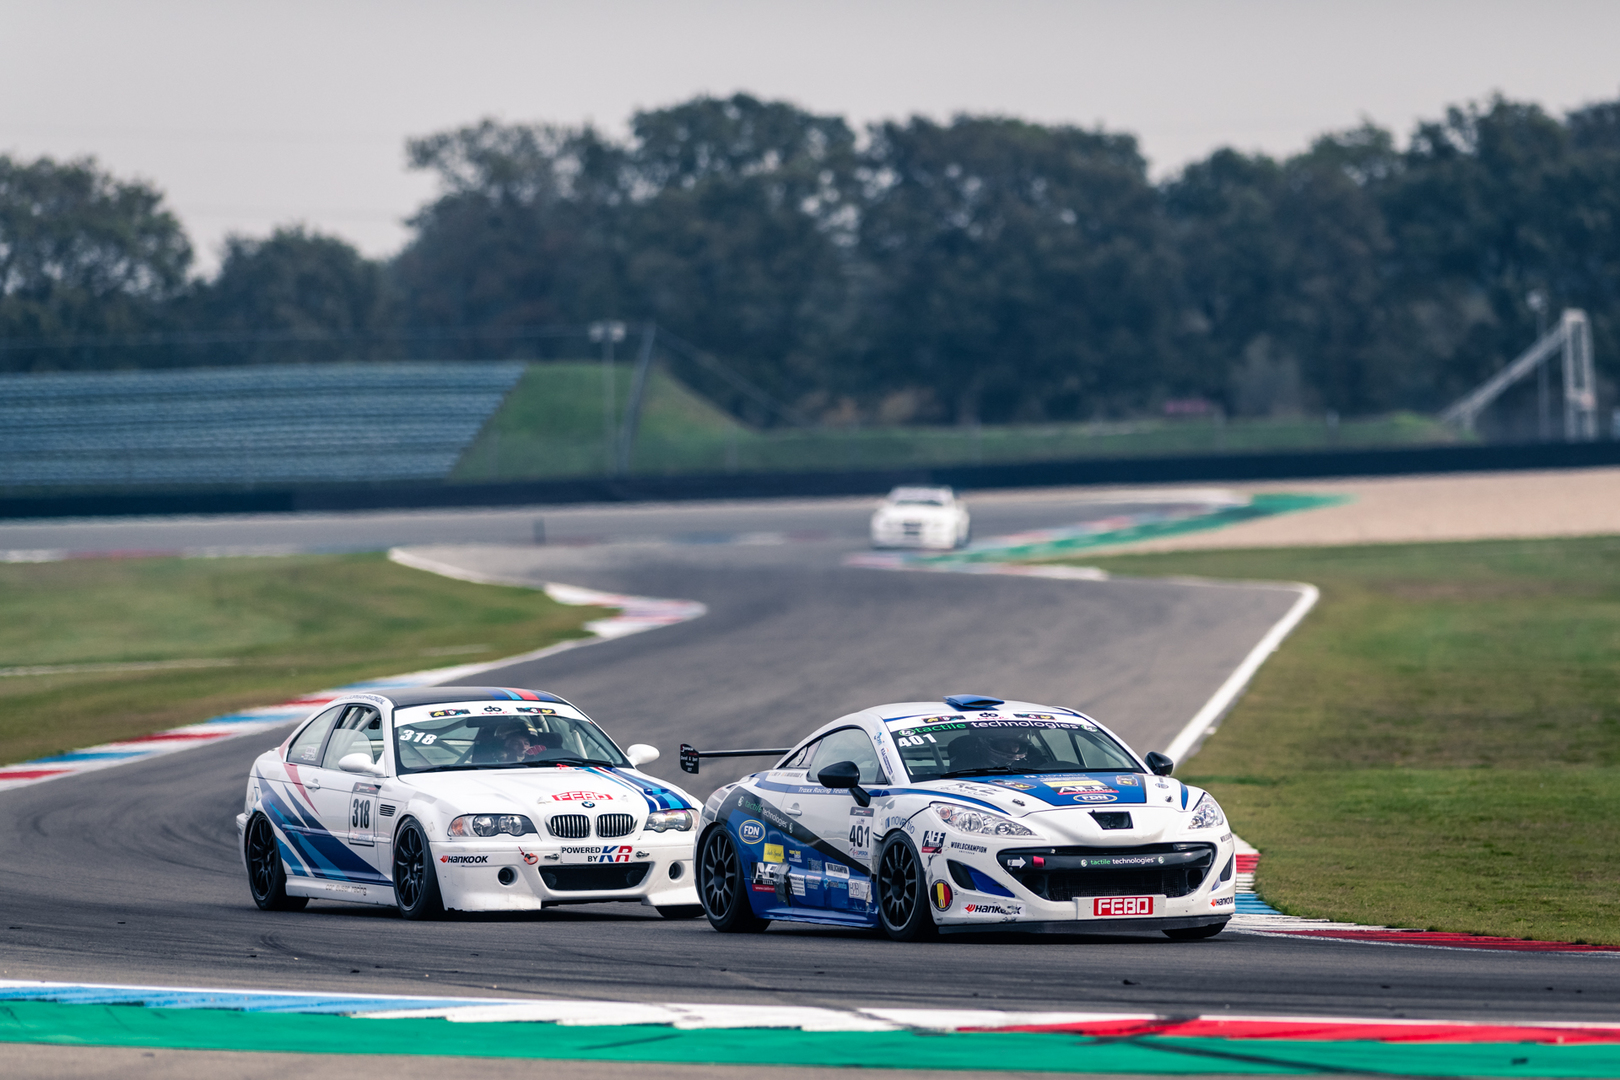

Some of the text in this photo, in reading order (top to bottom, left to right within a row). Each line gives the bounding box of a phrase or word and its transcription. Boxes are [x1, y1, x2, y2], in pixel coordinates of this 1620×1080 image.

[915, 720, 1079, 733] tactile technologies
[399, 729, 437, 745] 318
[898, 733, 937, 748] 401
[555, 791, 608, 801] FEBO
[352, 798, 371, 829] 318
[745, 800, 787, 828] tactile technologies
[743, 825, 760, 836] FDN
[849, 824, 870, 848] 401
[599, 845, 633, 862] KR
[950, 841, 988, 854] WORLDCHAMPION
[1090, 856, 1154, 866] tactile technologies
[1097, 898, 1150, 915] FEBO
